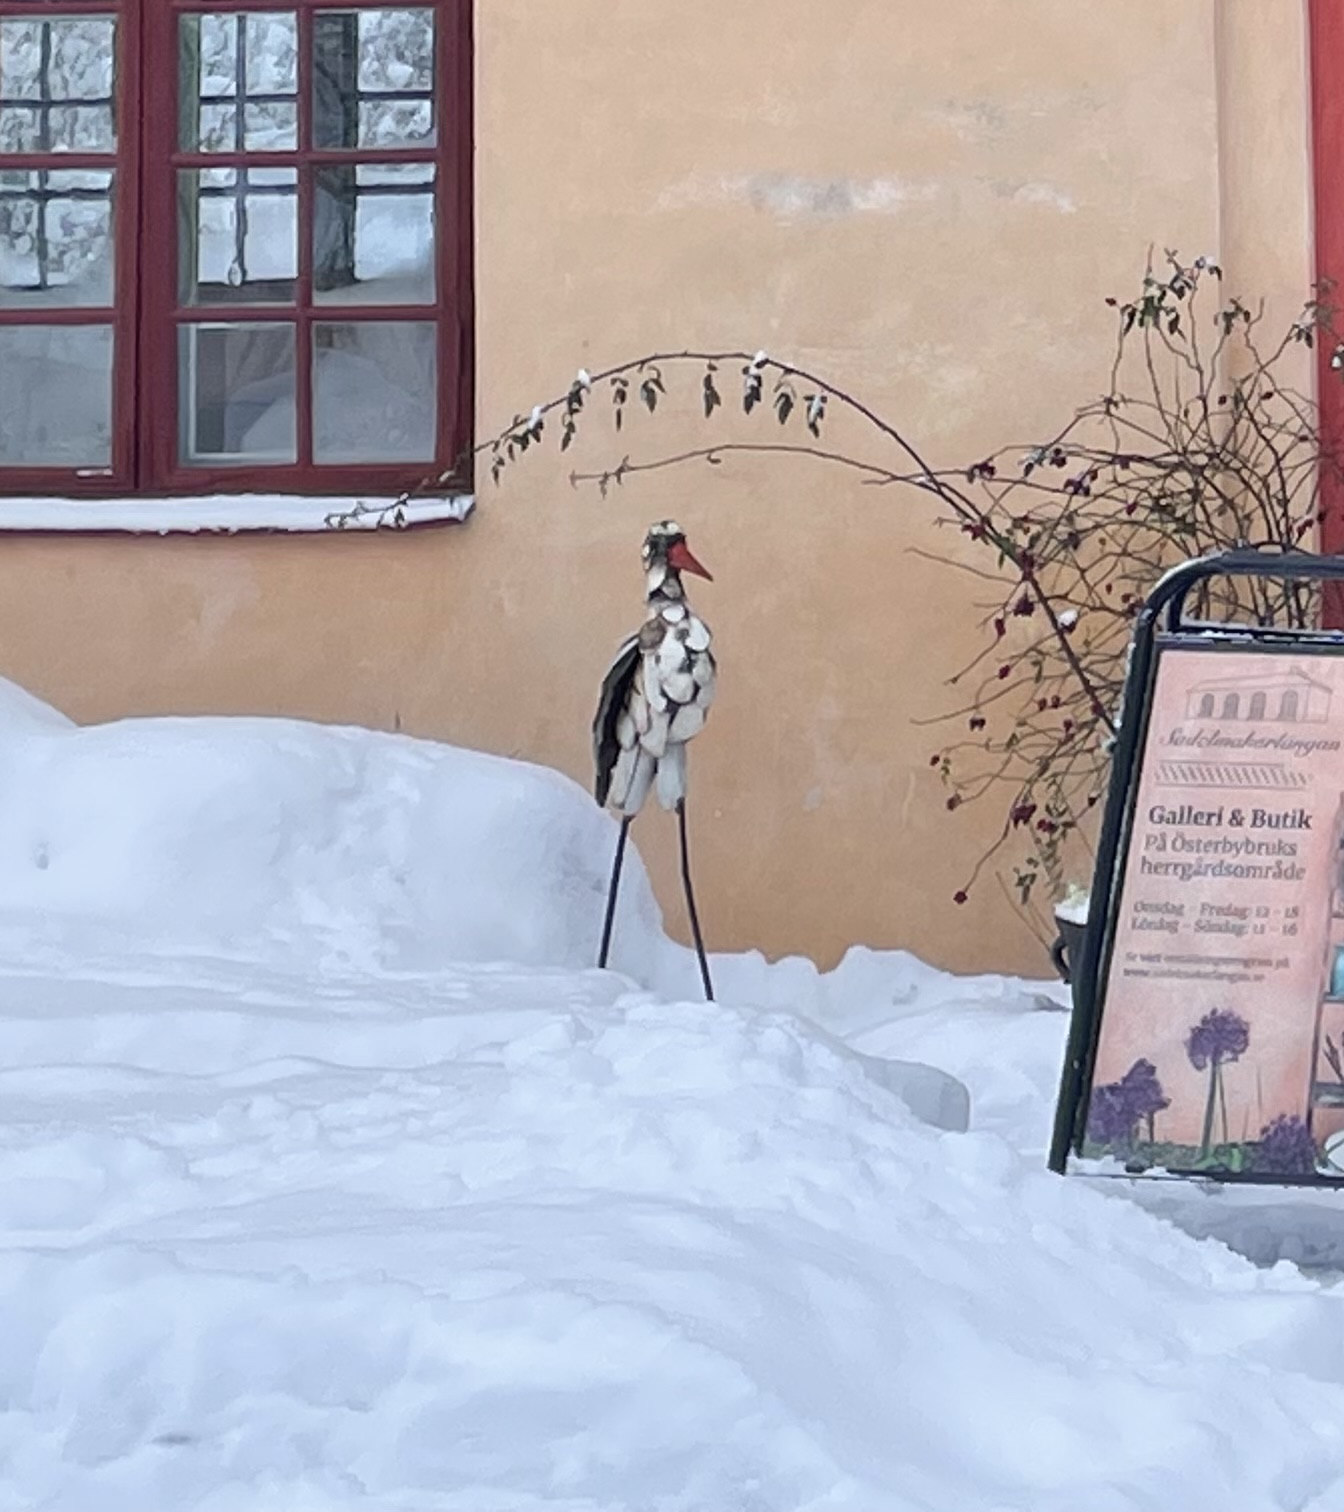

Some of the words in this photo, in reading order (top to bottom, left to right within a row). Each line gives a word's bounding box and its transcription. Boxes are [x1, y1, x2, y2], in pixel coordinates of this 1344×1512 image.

[1149, 805, 1225, 826] Galleri
[1228, 809, 1245, 828] &
[1250, 808, 1313, 830] Butik
[1144, 832, 1167, 852] På
[1171, 831, 1297, 858] Österbybruks
[1140, 855, 1306, 882] herrgårdsområde
